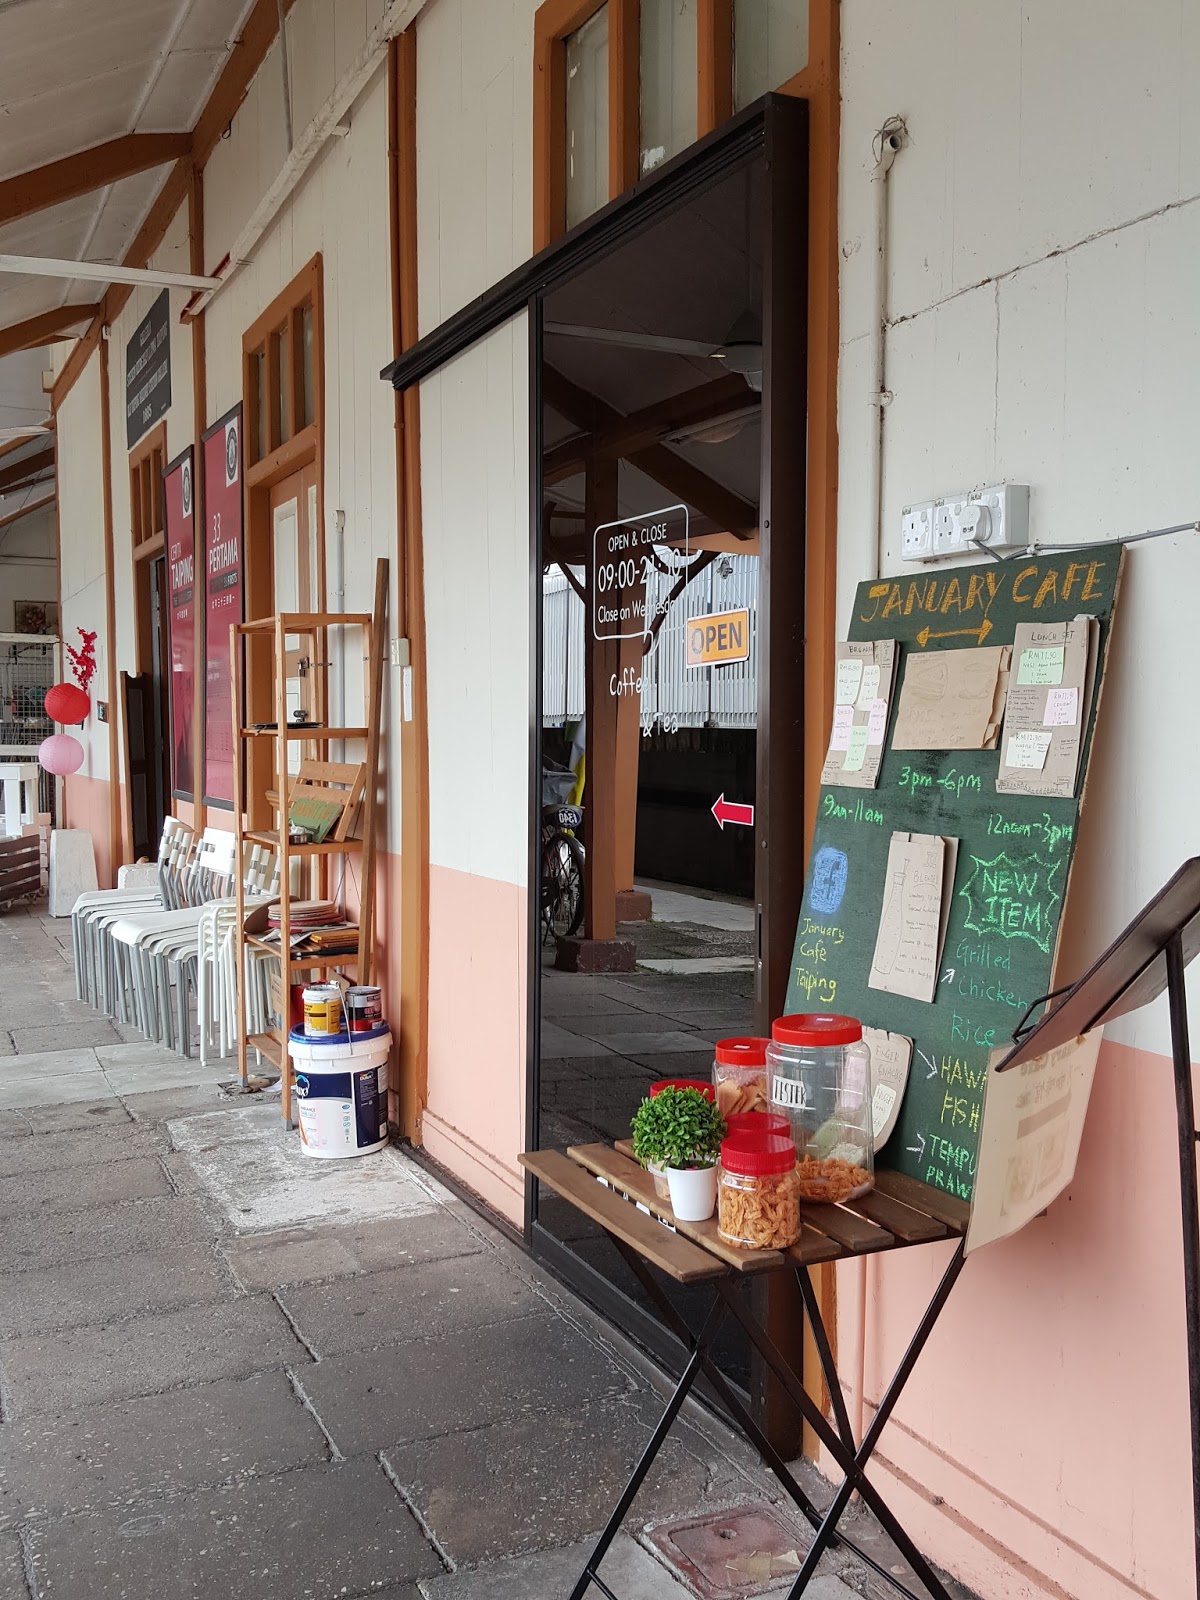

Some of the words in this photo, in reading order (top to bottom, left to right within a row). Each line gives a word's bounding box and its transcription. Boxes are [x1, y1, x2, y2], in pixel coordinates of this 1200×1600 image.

[212, 512, 221, 544] 33
[608, 532, 629, 553] OPEN
[632, 531, 639, 547] &
[641, 523, 667, 543] CLOSE
[171, 554, 193, 590] TAIPING
[209, 537, 238, 574] PERTAMA
[860, 572, 1006, 623] JANUARY
[1013, 561, 1105, 609] CAFE
[598, 606, 619, 624] Close
[620, 607, 631, 620] on
[691, 620, 743, 655] OPEN
[643, 708, 654, 738] &
[653, 711, 679, 736] Tea
[982, 870, 1039, 898] NEW
[801, 918, 846, 945] January
[984, 896, 1043, 933] ITEM
[956, 938, 1012, 970] Grilled
[795, 967, 838, 1003] Taiping
[957, 976, 1030, 1012] Chicken
[951, 1014, 996, 1047] Rice
[940, 1088, 982, 1133] FISH
